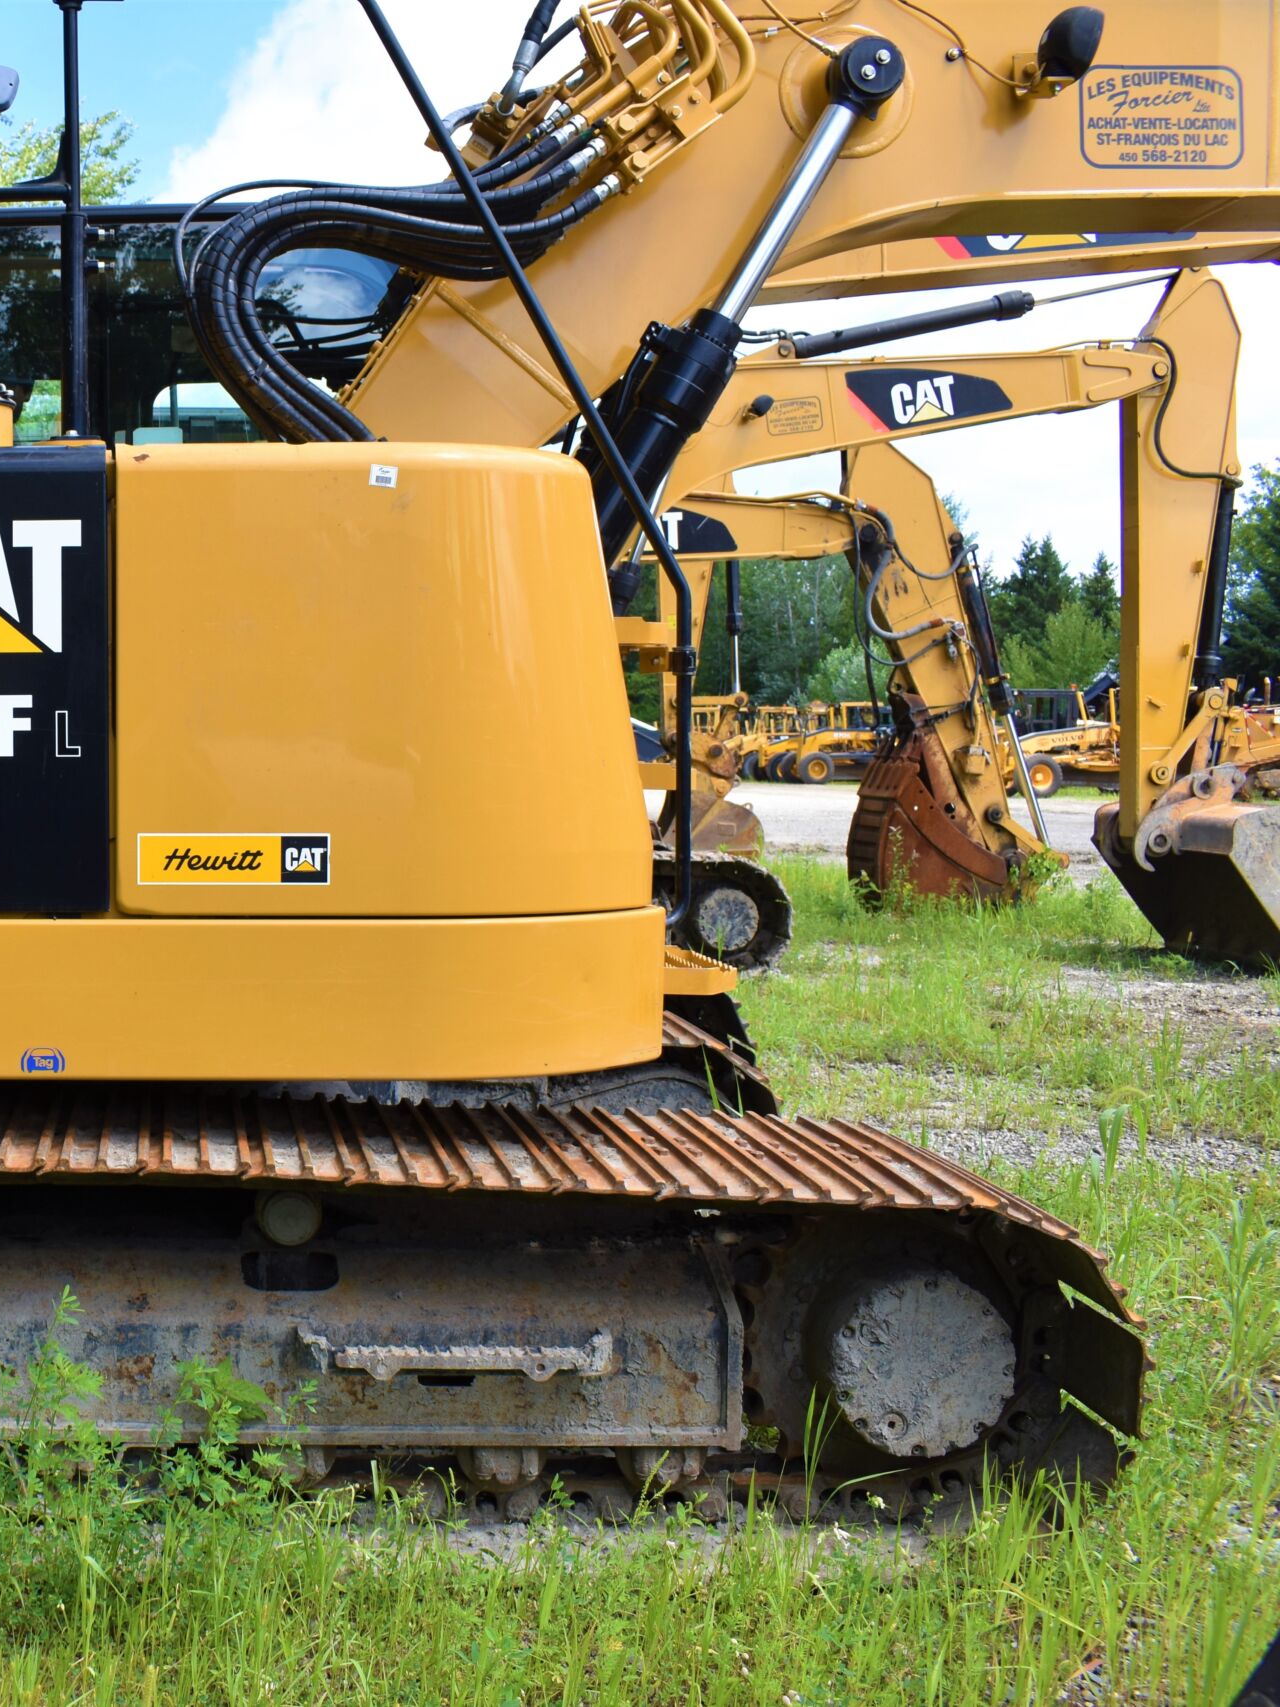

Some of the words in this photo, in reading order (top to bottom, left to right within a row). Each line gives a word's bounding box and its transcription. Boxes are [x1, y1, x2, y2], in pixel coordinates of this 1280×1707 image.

[1087, 78, 1116, 100] LES
[1121, 71, 1235, 101] EQUIPEMENTS
[1107, 90, 1194, 116] Forcier
[1087, 117, 1237, 131] ACHAT-VENTE-LOCATION
[1096, 133, 1179, 149] ST-FRANÇOIS
[1183, 134, 1200, 146] DU
[1204, 134, 1228, 146] LAC
[1119, 153, 1137, 162] 450
[1142, 150, 1207, 162] 568-2120
[890, 375, 954, 425] CAT
[55, 710, 82, 757] L
[1051, 734, 1085, 743] VOLVO
[163, 848, 264, 871] Hewitt
[285, 847, 325, 872] CAT
[32, 1057, 54, 1069] Tag
